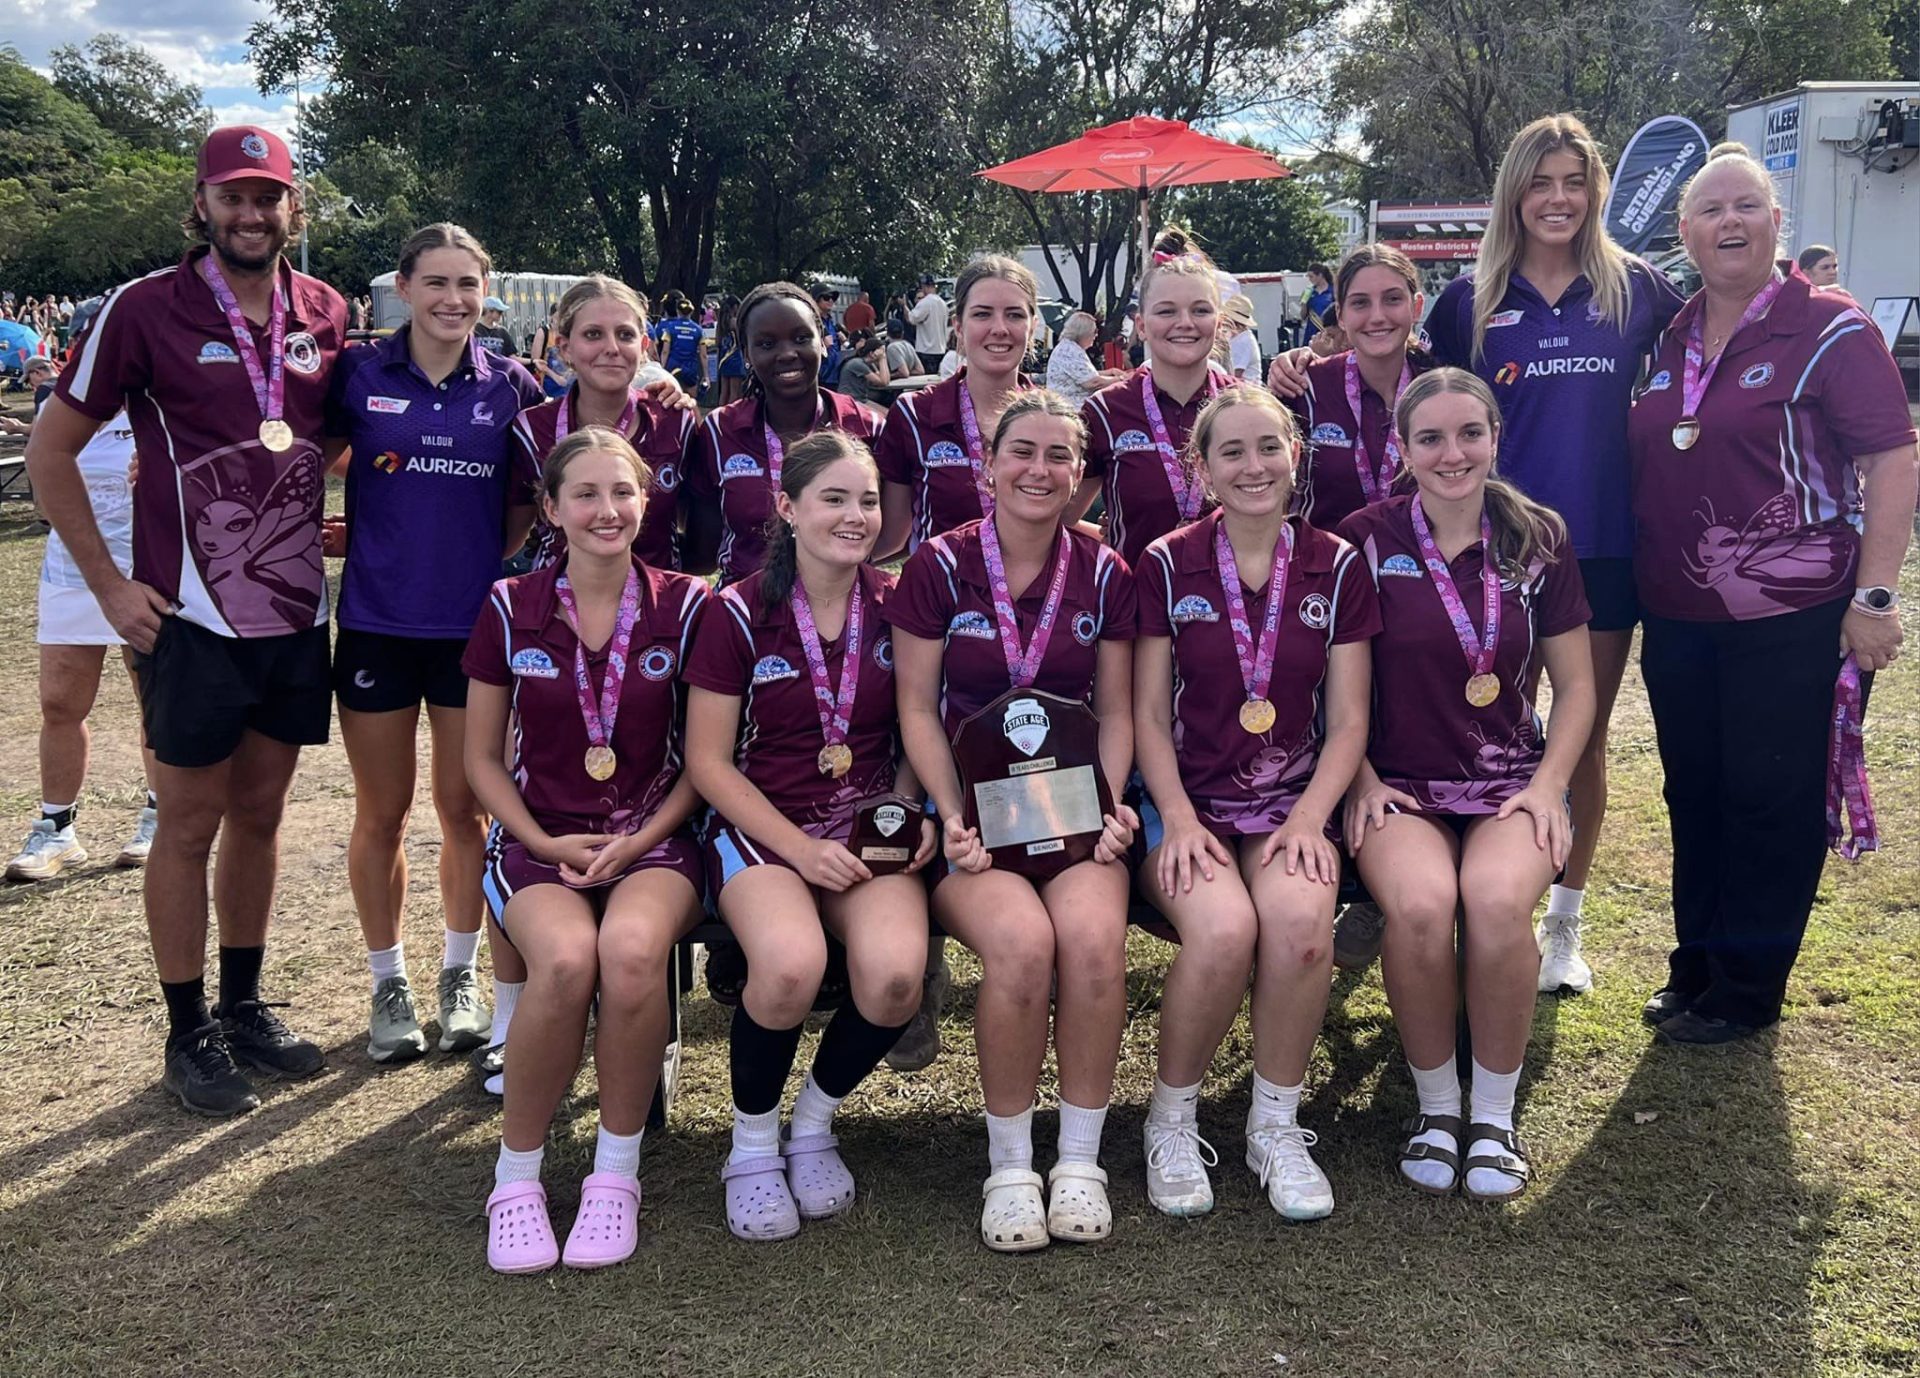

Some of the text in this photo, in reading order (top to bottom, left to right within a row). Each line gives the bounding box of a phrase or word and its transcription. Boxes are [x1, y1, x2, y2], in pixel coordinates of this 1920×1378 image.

[1771, 156, 1789, 171] HIRE
[1618, 165, 1666, 228] NETBALL
[1631, 141, 1696, 234] QUEENSLAND
[1400, 242, 1433, 251] Western
[1434, 241, 1469, 251] Districts
[1538, 336, 1569, 350] VALOUR
[1524, 357, 1616, 378] AURIZON
[421, 435, 453, 447] VALOUR
[405, 456, 495, 478] AURIZON
[1053, 570, 1065, 591] STATE
[1273, 568, 1285, 590] STATE
[1488, 572, 1497, 586] AGE
[1269, 589, 1281, 614] SENIOR
[1487, 586, 1497, 607] STATE
[1265, 614, 1277, 632] 2024
[1486, 607, 1497, 633] SENIOR
[1006, 715, 1030, 731] STATE
[1030, 715, 1047, 727] AGE
[1032, 843, 1059, 853] SENIOR
